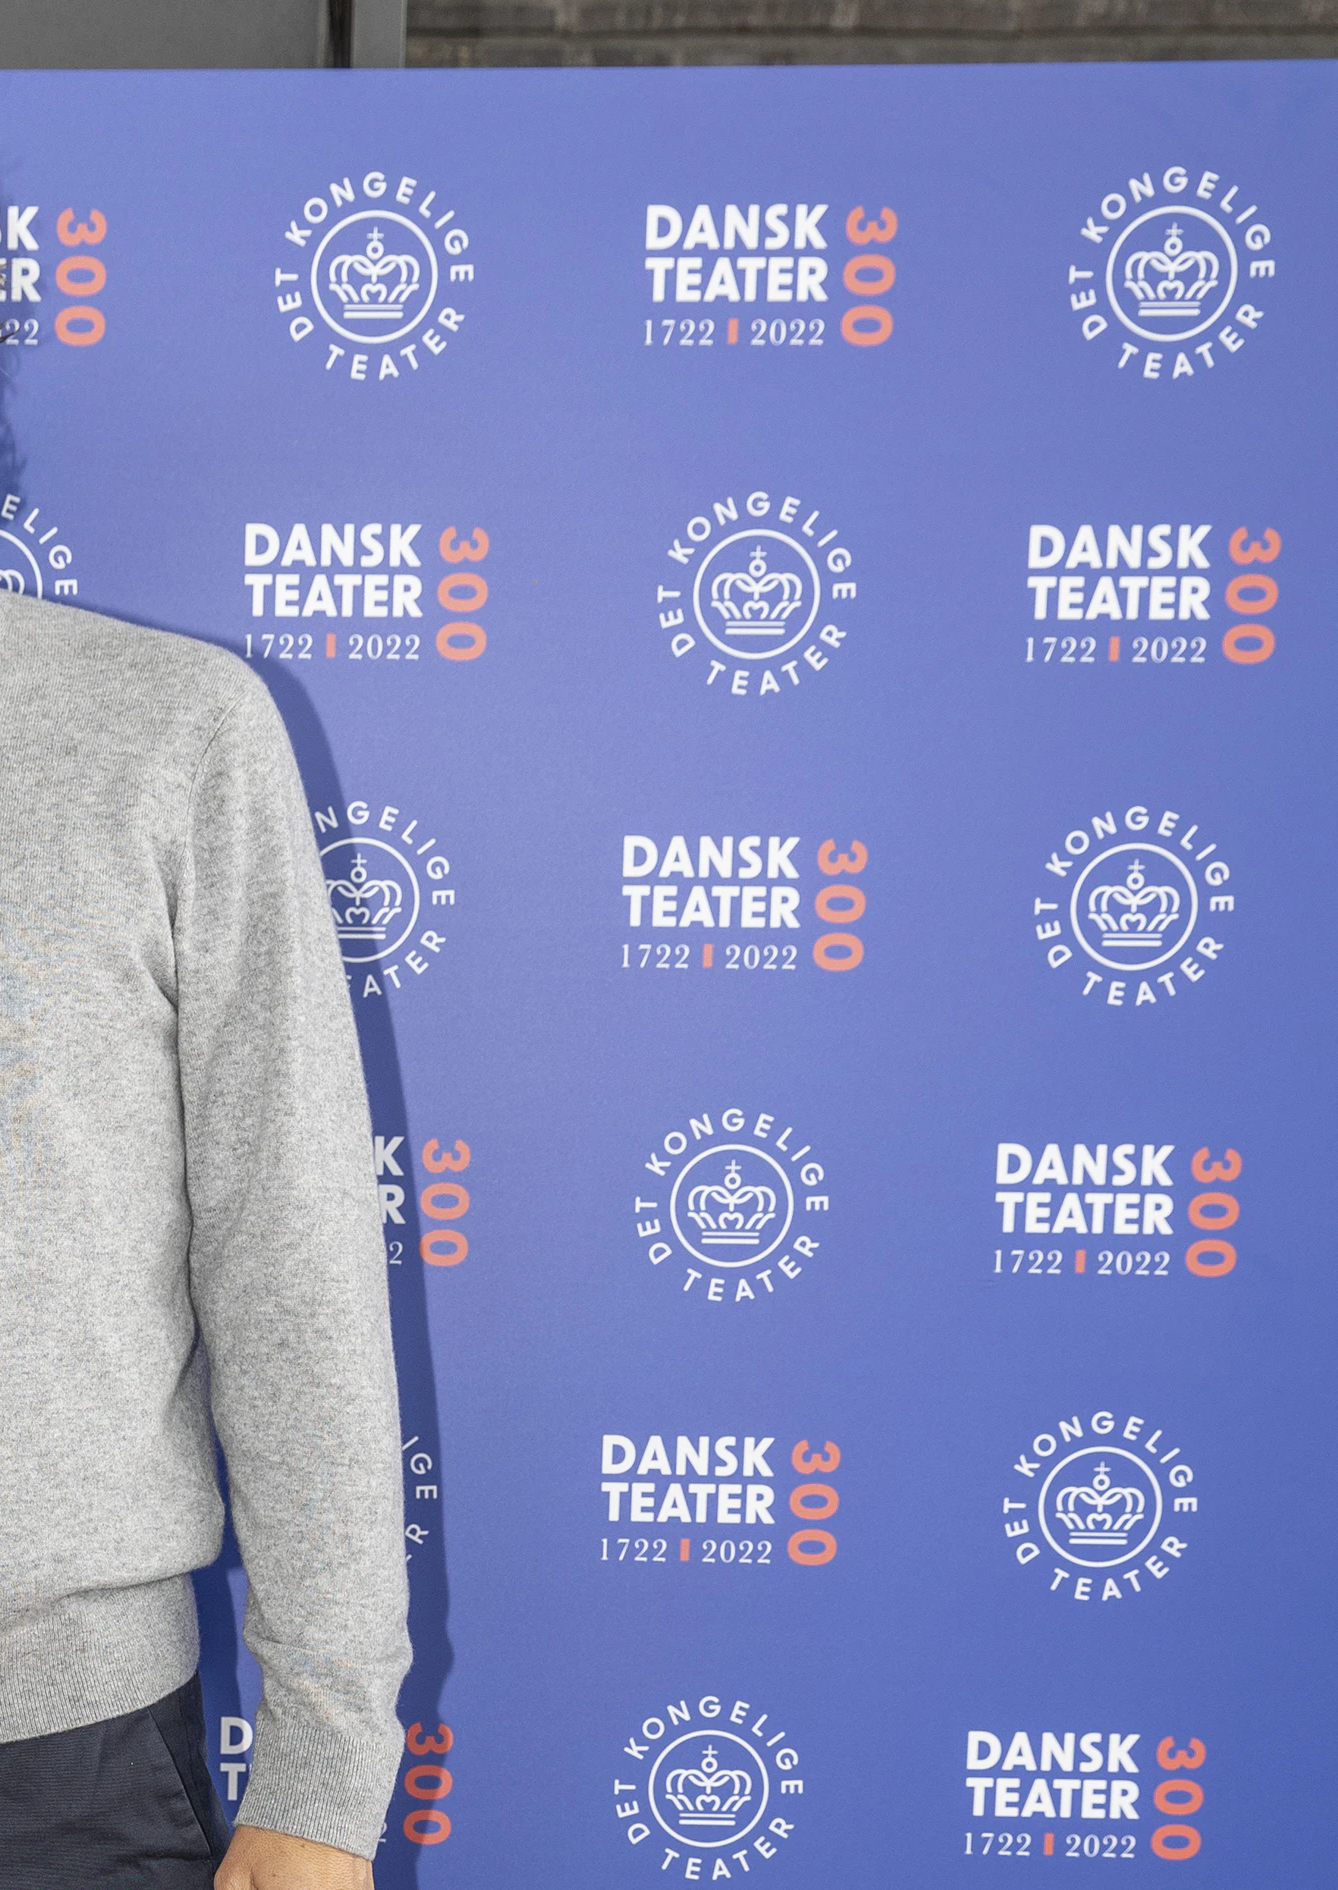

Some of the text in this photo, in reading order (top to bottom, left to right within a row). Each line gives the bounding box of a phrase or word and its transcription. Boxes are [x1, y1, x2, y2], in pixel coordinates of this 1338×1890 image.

[645, 203, 829, 251] DANSK
[55, 208, 108, 347] 300
[274, 171, 474, 381] DET KONGELIGE TEATER
[644, 256, 829, 303] TEATER
[841, 207, 897, 345] 300
[1068, 166, 1276, 380] DET KONGELIGE TEATER
[645, 318, 825, 346] 1722 2022
[244, 522, 422, 568] DANSK
[1027, 523, 1213, 570] DANSK
[244, 573, 424, 618] TEATER
[436, 526, 490, 661] 300
[657, 491, 857, 696] DET KONGELIGE TEATER
[1026, 575, 1211, 621] TEATER
[1223, 527, 1281, 663] 300
[245, 633, 421, 660] 1722 2022
[1026, 636, 1207, 663] 1722 2022
[622, 835, 800, 879] DANSK
[621, 884, 801, 929] TEATER
[813, 839, 868, 971] 300
[622, 943, 798, 970] 1722 2022
[995, 1142, 1175, 1187] DANSK
[420, 1138, 471, 1267] 300
[994, 1191, 1174, 1236] TEATER
[1186, 1148, 1241, 1277] 300
[994, 1249, 1171, 1276] 1722 2022
[601, 1434, 775, 1478] DANSK
[600, 1481, 776, 1525] TEATER
[788, 1440, 841, 1565] 300
[1002, 1410, 1198, 1602] DET KONGELIGE TEATER
[601, 1537, 772, 1565] 1722 2022
[966, 1730, 1141, 1774] DANSK
[403, 1721, 454, 1845] 300
[965, 1776, 1140, 1820] TEATER
[1152, 1737, 1205, 1860] 300
[964, 1832, 1137, 1859] 1722 2022
